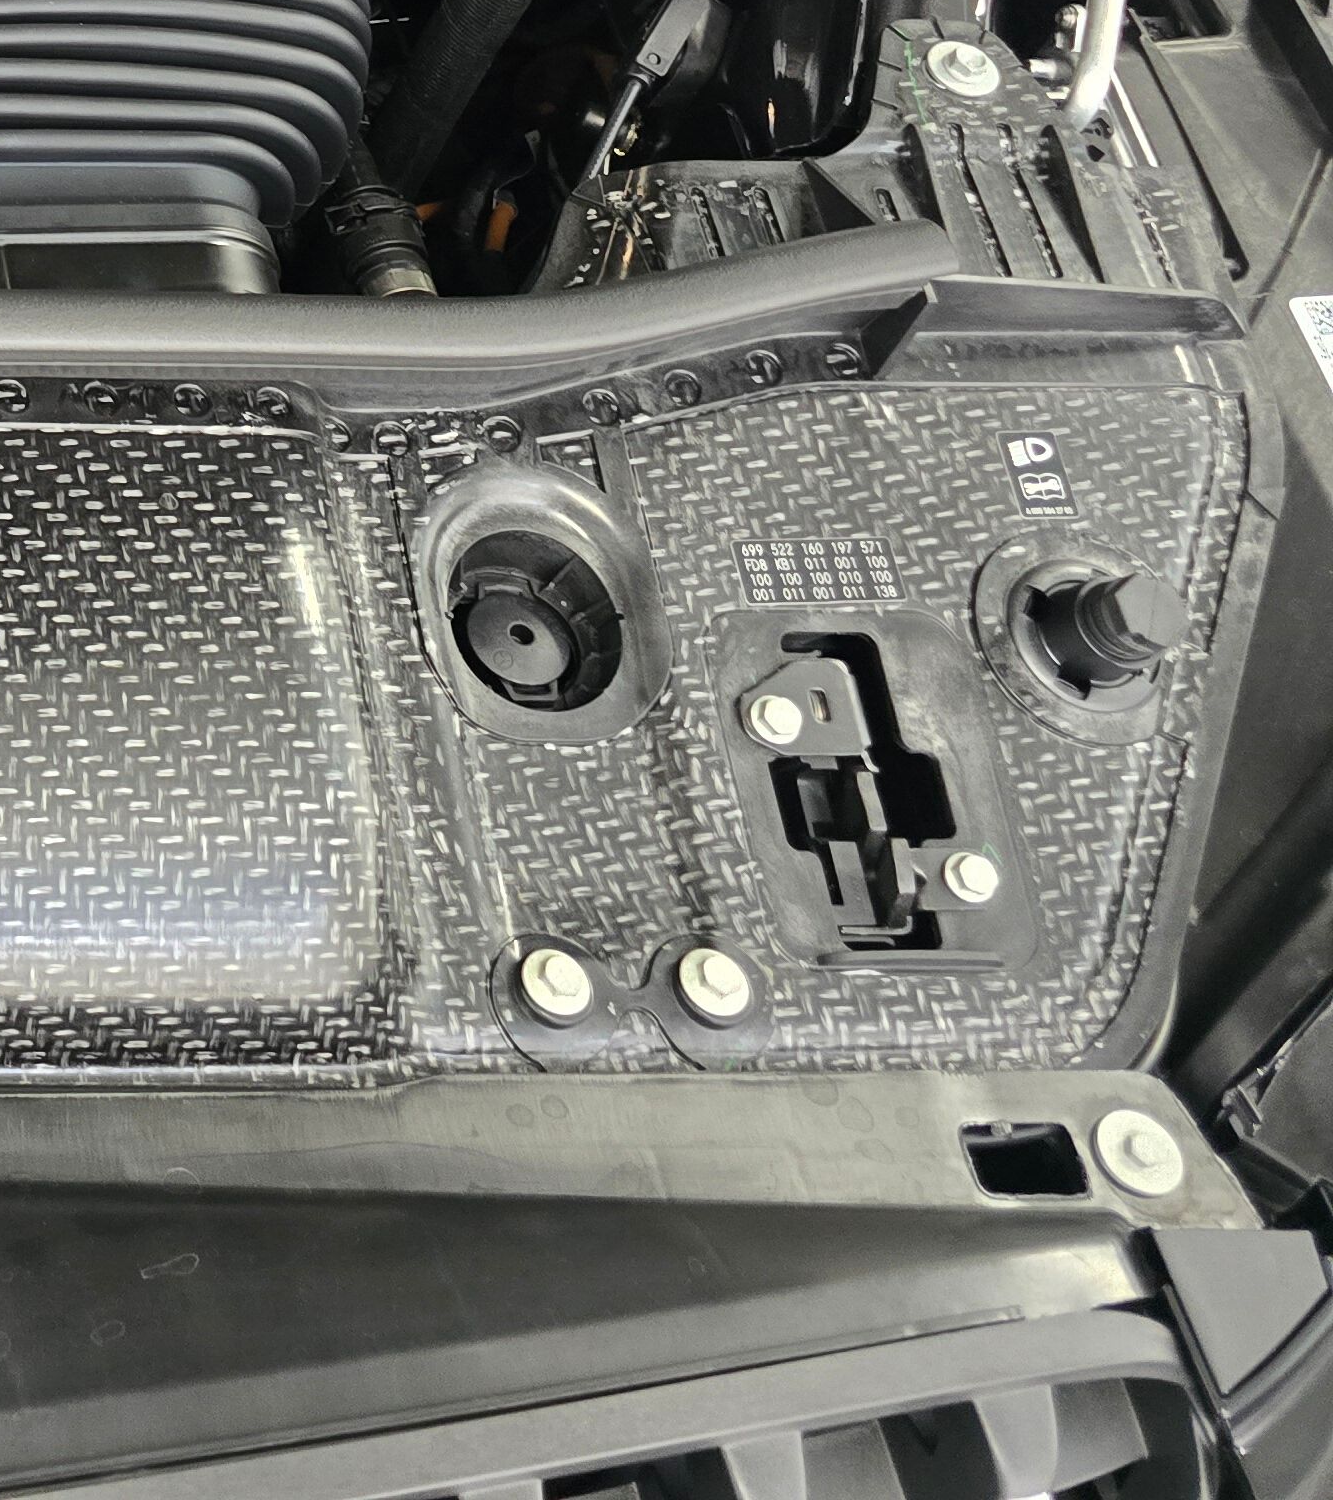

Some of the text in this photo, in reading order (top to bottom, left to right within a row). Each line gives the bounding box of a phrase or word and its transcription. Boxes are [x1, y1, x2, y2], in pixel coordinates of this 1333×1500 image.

[742, 541, 883, 556] 699 522 160 197 571
[744, 556, 888, 571] FD8 KB1 011 001 100
[751, 571, 893, 586] 100 100 100 010 100
[753, 585, 897, 601] 001 011 001 011 138
